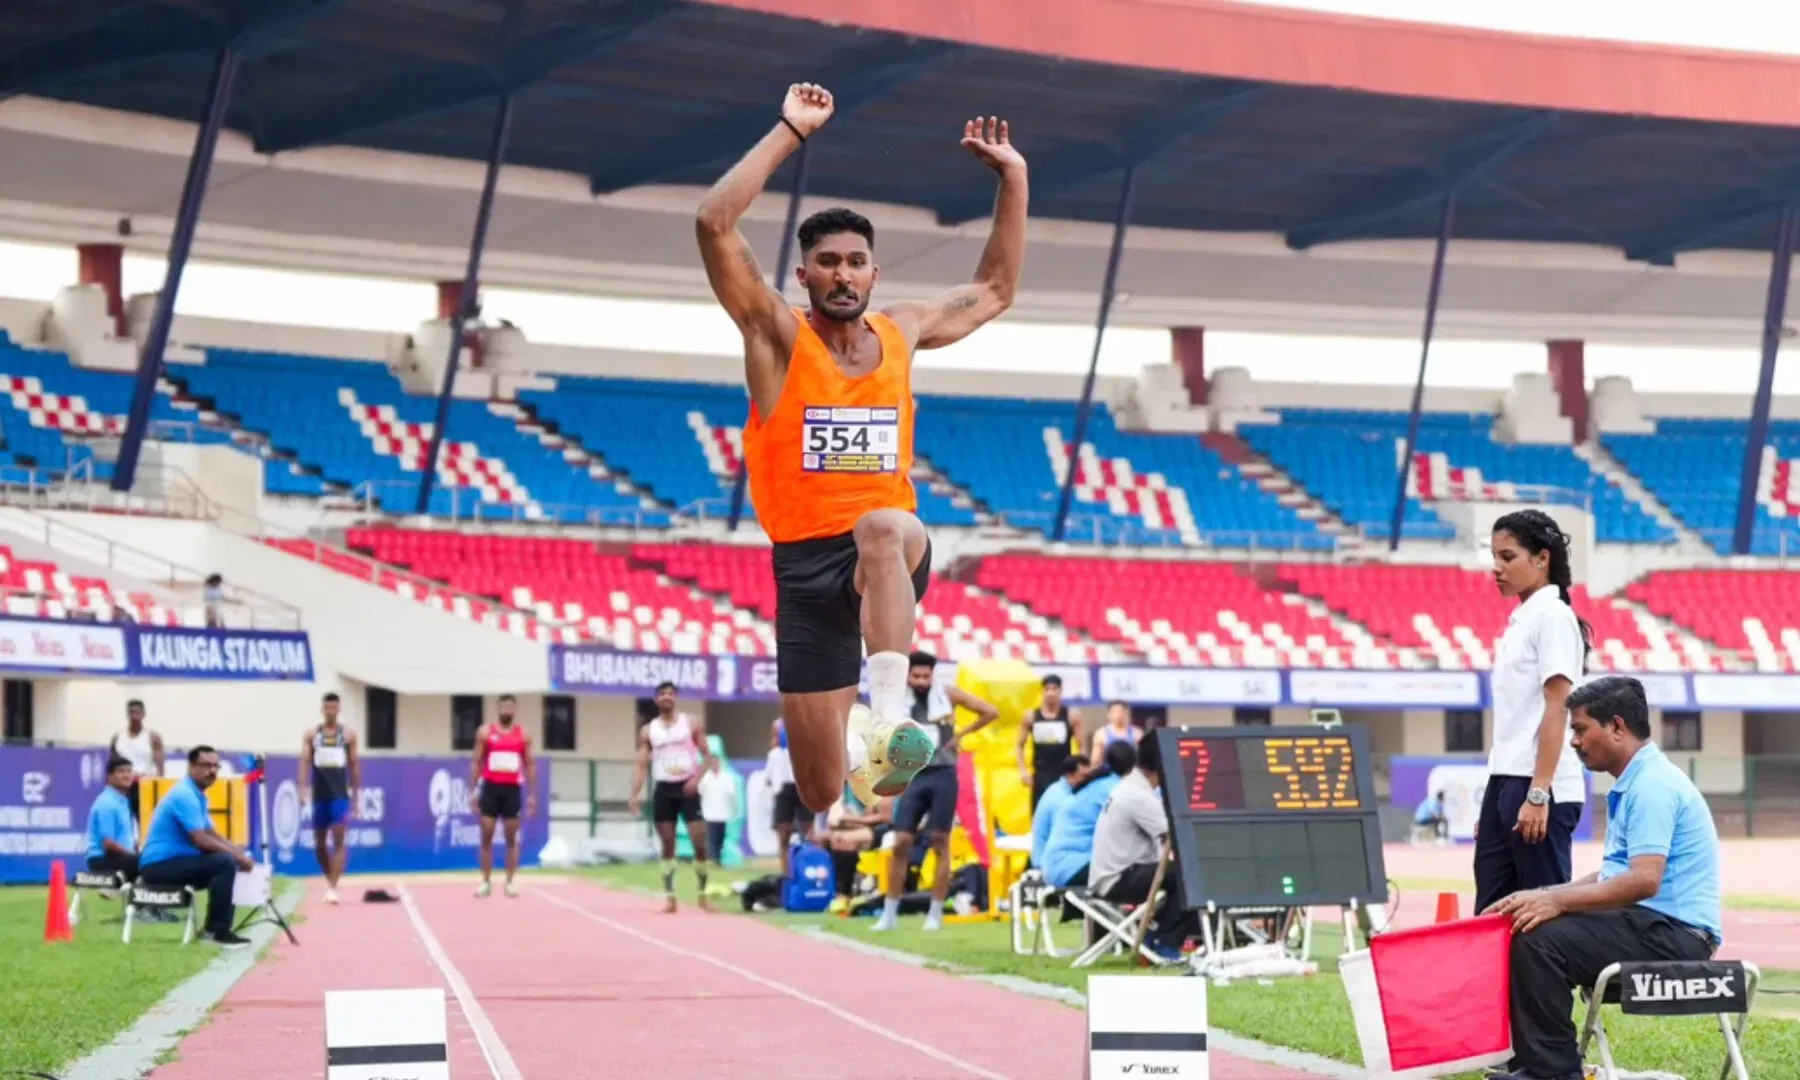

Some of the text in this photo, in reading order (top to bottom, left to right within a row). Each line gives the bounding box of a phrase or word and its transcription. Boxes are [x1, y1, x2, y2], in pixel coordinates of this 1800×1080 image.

[809, 427, 870, 452] 554
[139, 632, 224, 671] KALINGA
[226, 636, 306, 672] STADIUM
[563, 651, 708, 689] BHUBANESWAR
[1179, 740, 1217, 809] 2
[1264, 738, 1359, 808] 592
[1631, 974, 1735, 1001] Vinex
